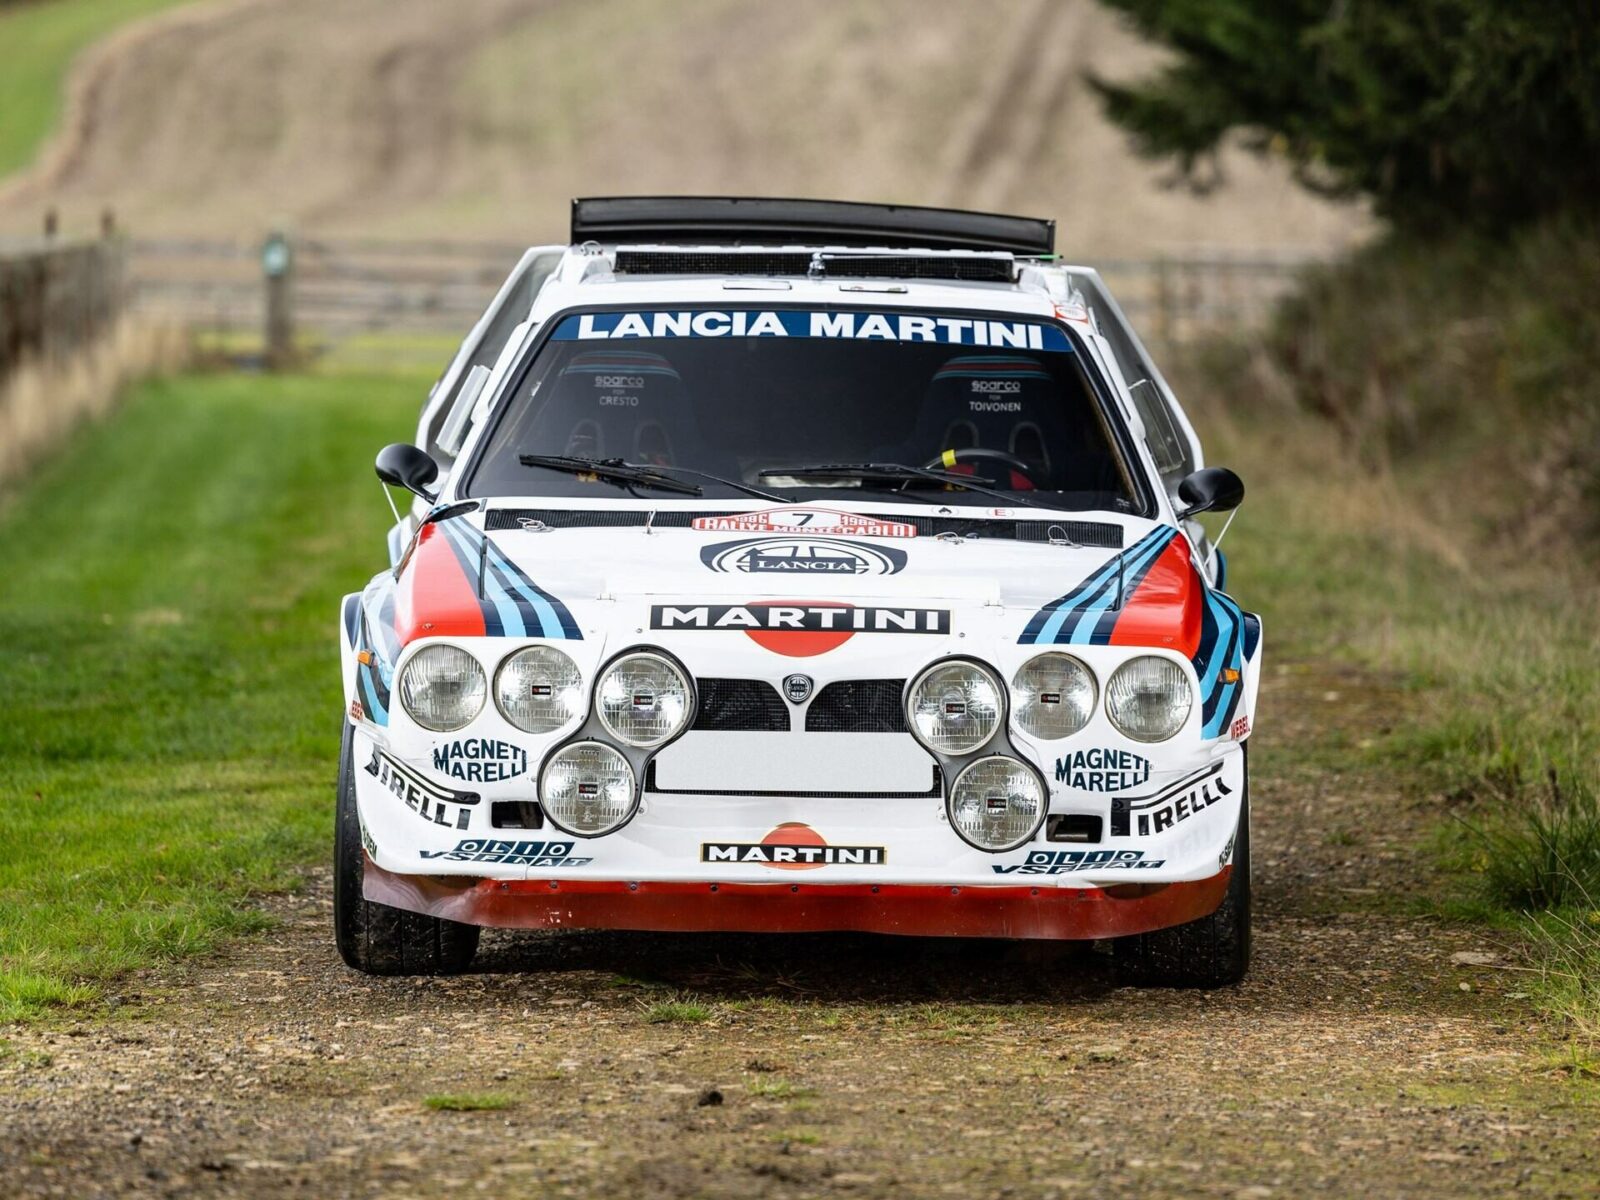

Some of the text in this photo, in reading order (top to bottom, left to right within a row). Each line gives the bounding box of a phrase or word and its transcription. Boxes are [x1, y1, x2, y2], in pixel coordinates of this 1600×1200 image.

[578, 311, 1044, 350] LANCIA MARTINI
[594, 375, 645, 389] sparco
[971, 380, 1021, 393] sparco
[599, 396, 639, 406] CRESTO
[969, 401, 1021, 412] TOIVONEN
[792, 513, 814, 527] 7
[757, 560, 854, 571] LANCIA
[661, 606, 939, 631] MARTINI
[434, 739, 526, 761] MAGNETI
[1056, 748, 1149, 771] MAGNETI
[434, 760, 526, 782] MARELLI
[1056, 770, 1149, 792] MARELLI
[1111, 758, 1232, 836] PIRELLI
[458, 840, 570, 856] OLIO
[708, 846, 879, 863] MARTINI
[1029, 851, 1141, 865] OLIO
